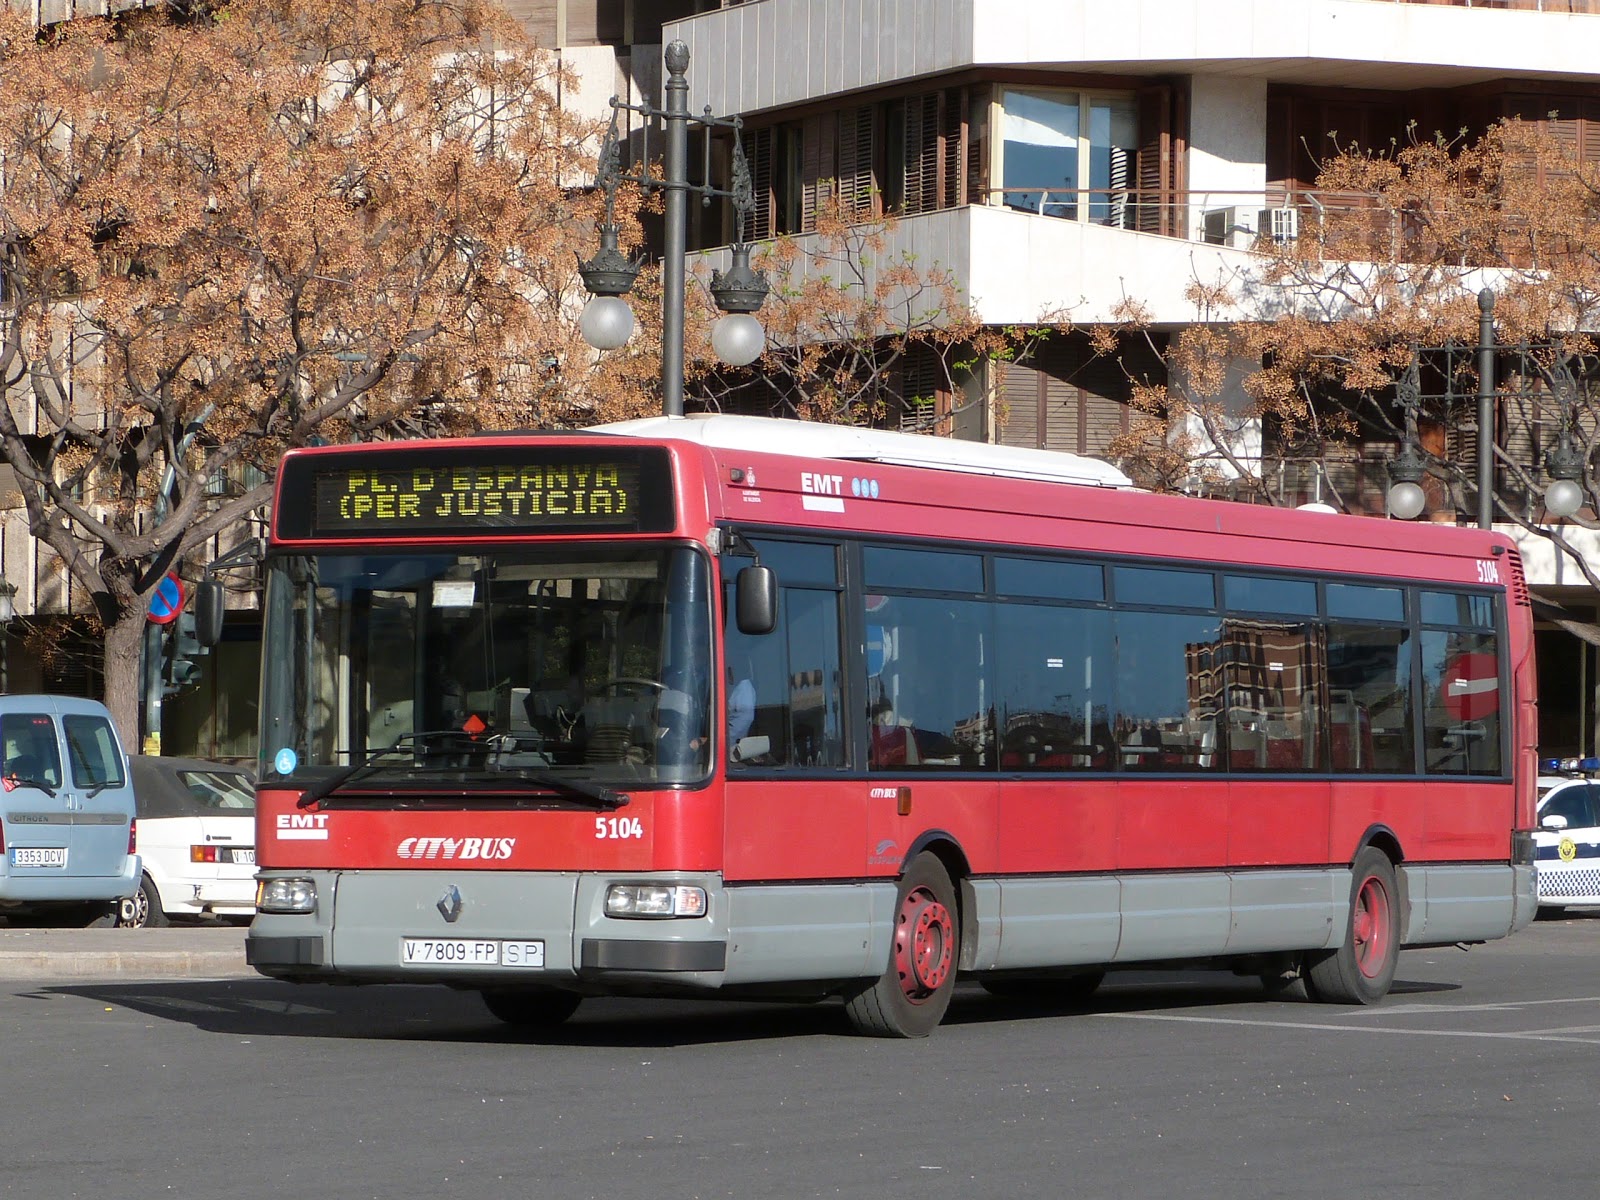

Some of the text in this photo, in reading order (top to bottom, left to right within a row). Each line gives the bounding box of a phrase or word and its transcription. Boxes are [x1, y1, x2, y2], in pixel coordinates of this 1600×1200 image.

[348, 463, 619, 492] PL. D'ESPANYA
[801, 472, 843, 495] EMT
[340, 488, 628, 519] (PER JUSTICIA)
[1476, 560, 1498, 583] 5104
[276, 814, 328, 828] EMT
[595, 817, 643, 839] 5104
[18, 850, 62, 862] 3353 DCV
[396, 837, 516, 860] CITYBUS
